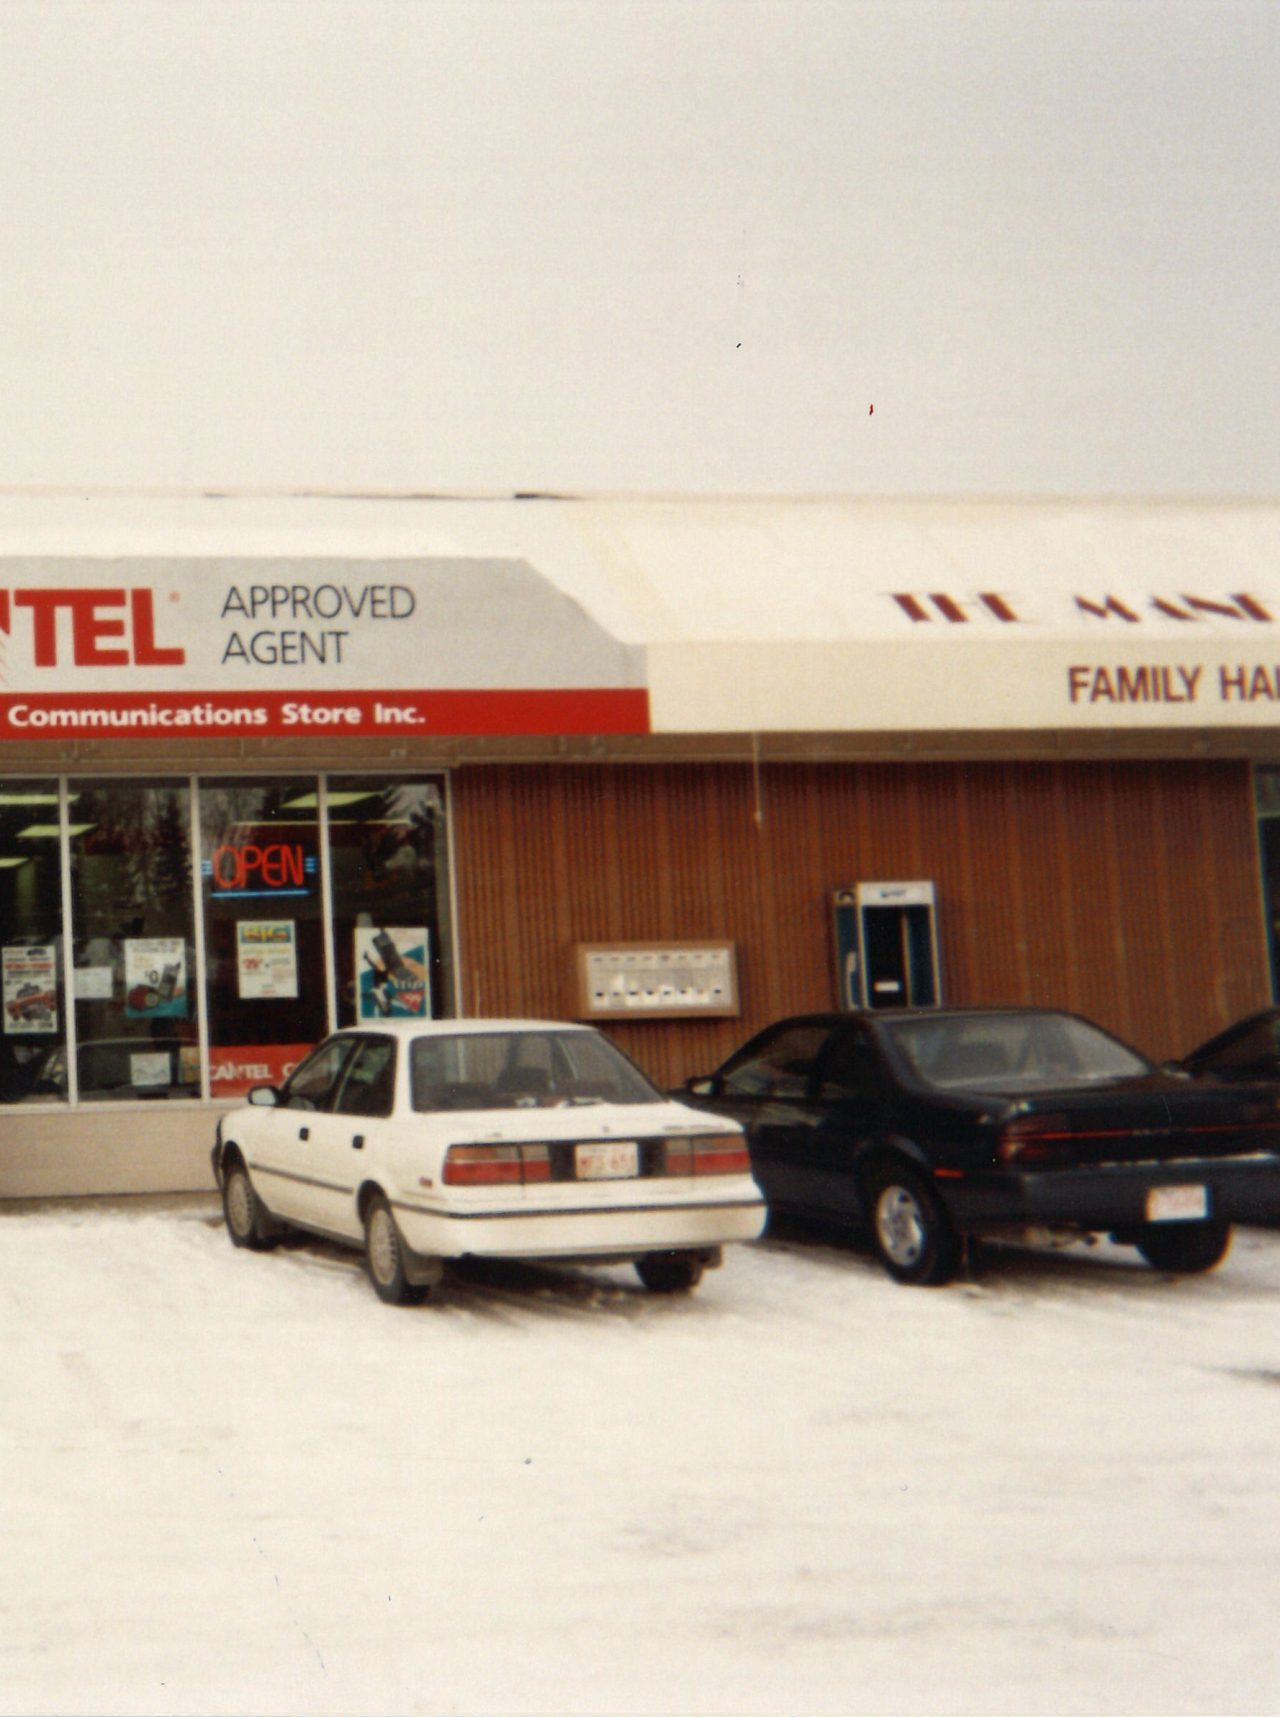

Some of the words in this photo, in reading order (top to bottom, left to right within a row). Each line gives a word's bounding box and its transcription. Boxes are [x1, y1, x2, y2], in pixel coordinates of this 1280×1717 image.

[220, 584, 417, 620] APPROVED
[221, 630, 350, 666] AGENT
[1068, 665, 1202, 703] FAMILY
[6, 702, 269, 728] Communications
[280, 701, 363, 726] Store
[373, 701, 426, 725] Inc.
[212, 844, 305, 889] OPEN
